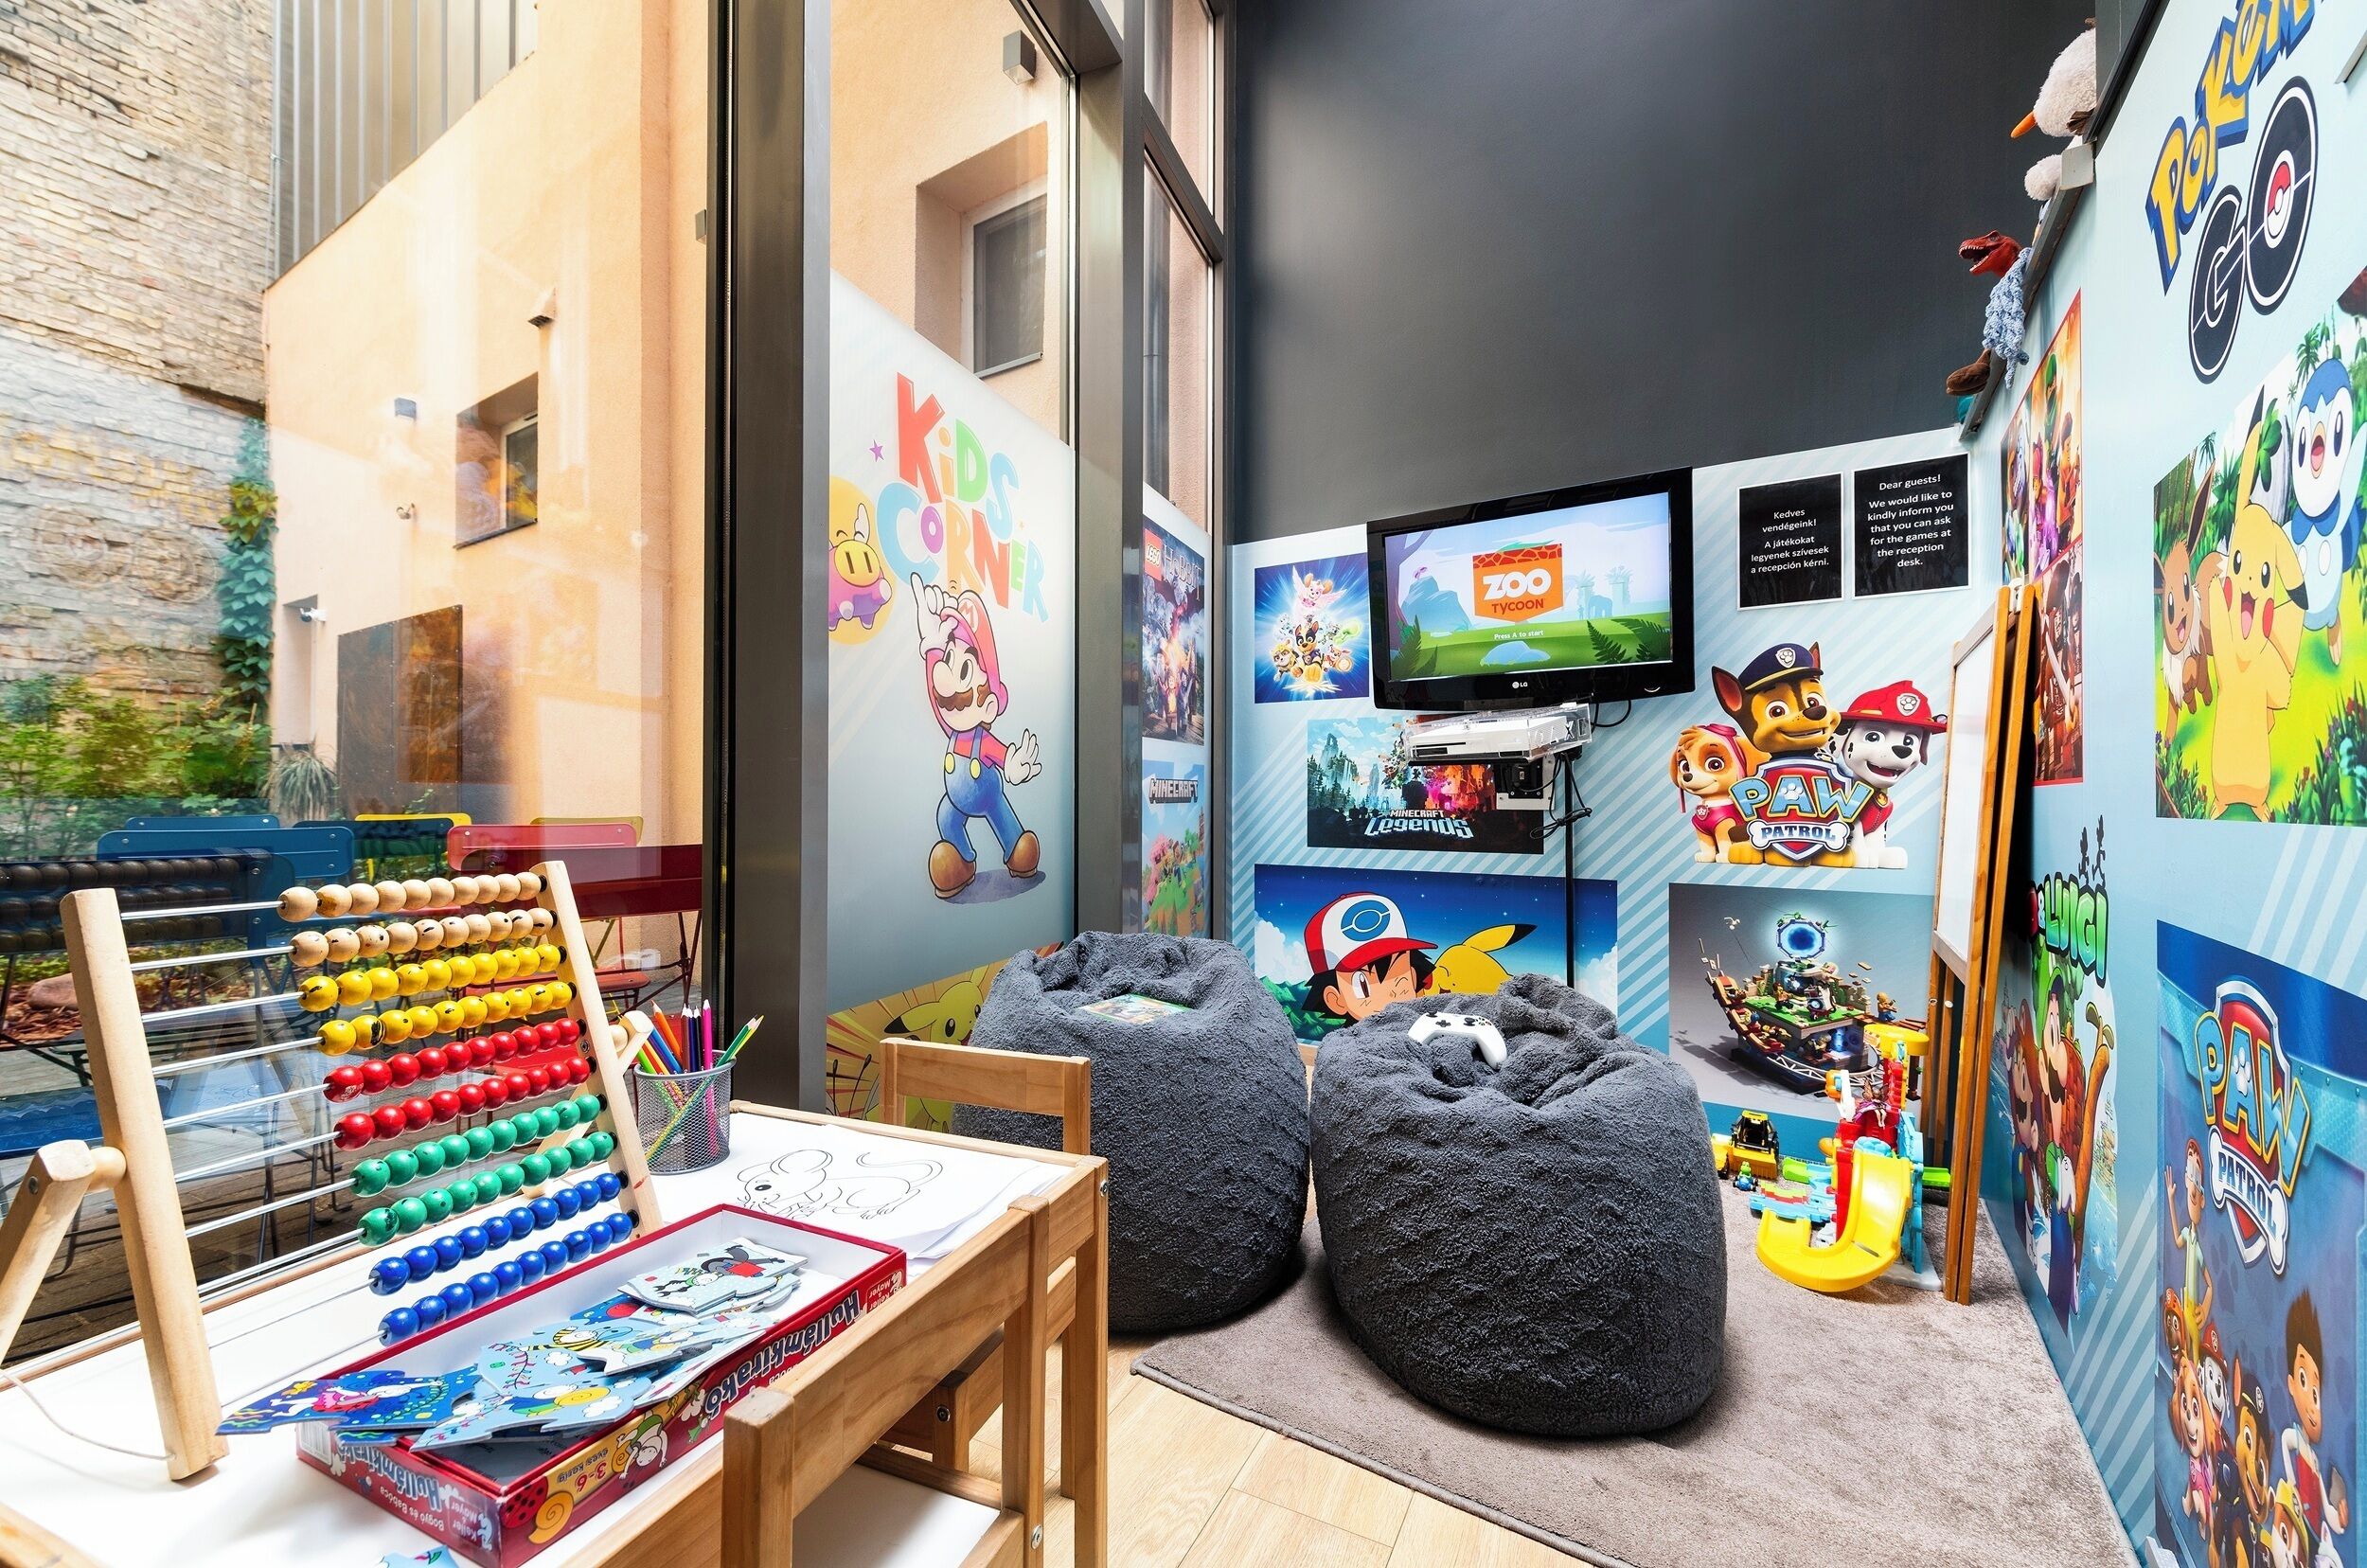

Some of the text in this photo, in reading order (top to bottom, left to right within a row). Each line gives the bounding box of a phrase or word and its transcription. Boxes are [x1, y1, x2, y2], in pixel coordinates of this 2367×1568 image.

[2188, 76, 2319, 384] GO
[1879, 473, 1941, 491] Dear guests!
[1869, 490, 1952, 509] We would like to
[1773, 508, 1806, 520] Kedves
[1867, 504, 1954, 523] kindly inform you
[1762, 518, 1817, 534] vendégeink!
[1870, 516, 1951, 533] that you can ask
[1764, 535, 1815, 549] A játékokat
[1870, 528, 1951, 545] for the games at
[876, 481, 1048, 622] CORNER
[1146, 543, 1160, 568] LEGO
[1752, 545, 1829, 563] legyenek szívesek
[1878, 543, 1944, 558] the reception
[1758, 561, 1802, 574] recepción
[1803, 557, 1829, 569] kérni.
[1897, 559, 1923, 568] desk.
[1483, 568, 1552, 601] ZOO
[1491, 598, 1544, 615] TYCOON
[1149, 778, 1198, 804] MINECRAFT
[1730, 775, 1875, 822] PAW
[1390, 810, 1445, 818] MINECRAFT
[1363, 817, 1474, 839] Legends
[1760, 825, 1836, 841] PATROL
[2044, 872, 2109, 988] LUIGI
[2195, 1011, 2310, 1197] PAW
[2217, 1151, 2277, 1241] PATROL
[868, 1278, 891, 1298] Mayer
[703, 1290, 860, 1420] Hullámkirakó
[575, 1461, 608, 1493] 3-6
[380, 1486, 445, 1532] Bogyó és Babóca
[451, 1501, 477, 1523] Mayer
[452, 1519, 477, 1541] Keller
